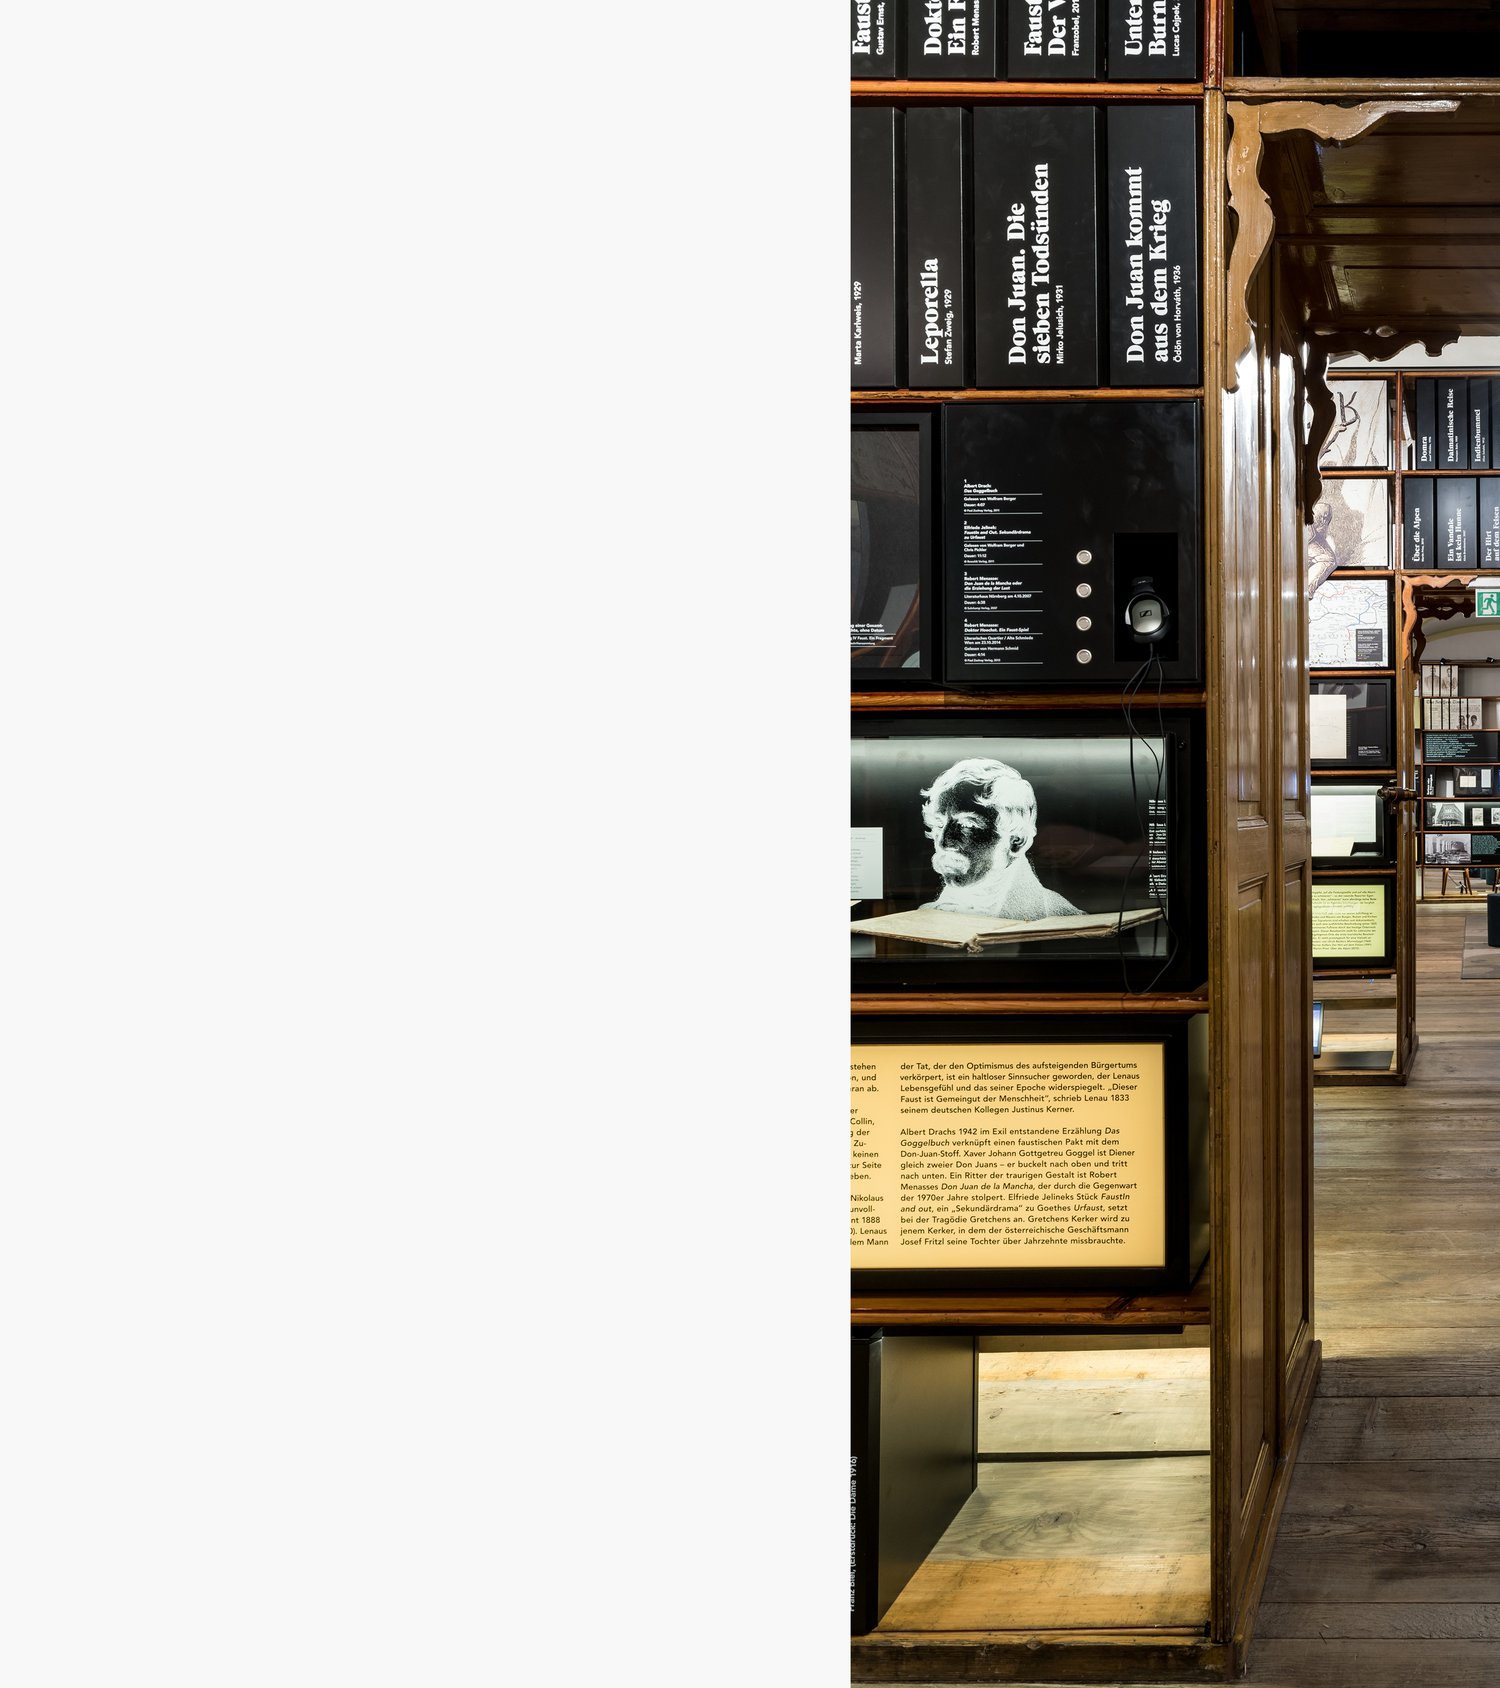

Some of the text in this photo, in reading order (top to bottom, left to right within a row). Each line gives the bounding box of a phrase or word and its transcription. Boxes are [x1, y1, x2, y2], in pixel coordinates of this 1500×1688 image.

[876, 2, 885, 55] Gustav Ernst,
[924, 0, 942, 55] Dokt
[948, 17, 966, 55] Ein
[971, 28, 979, 55] Robert
[1048, 15, 1066, 56] Der
[1072, 15, 1080, 56] Franzobel,
[1172, 3, 1181, 56] Lucas
[1030, 163, 1050, 363] sieben Todsünden
[1125, 167, 1144, 362] Don Juan kommt
[1007, 203, 1026, 364] Don Juan. Die
[1149, 199, 1171, 362] aus dem Krieg
[920, 258, 943, 364] Leporella
[1173, 287, 1182, 321] Horváth,
[944, 289, 954, 364] Stefan Zweig, 1929
[1056, 306, 1064, 339] Jelusich,
[854, 341, 862, 364] Marta
[1056, 341, 1064, 364] Mirko
[1173, 340, 1182, 362] Ödön
[1413, 508, 1421, 529] Alpen
[1447, 518, 1455, 547] Vandale
[1455, 508, 1463, 532] Hunne
[1412, 544, 1420, 561] Über
[900, 1074, 943, 1082] verkörpert,
[1052, 1072, 1094, 1082] geworden,
[967, 1062, 1013, 1071] Optimismus
[1032, 1062, 1088, 1070] aufsteigenden
[1091, 1062, 1137, 1070] Bürgertums
[901, 1084, 953, 1093] Lebensgefühl
[1017, 1084, 1046, 1092] Epoche
[1048, 1083, 1105, 1092] widerspiegelt.
